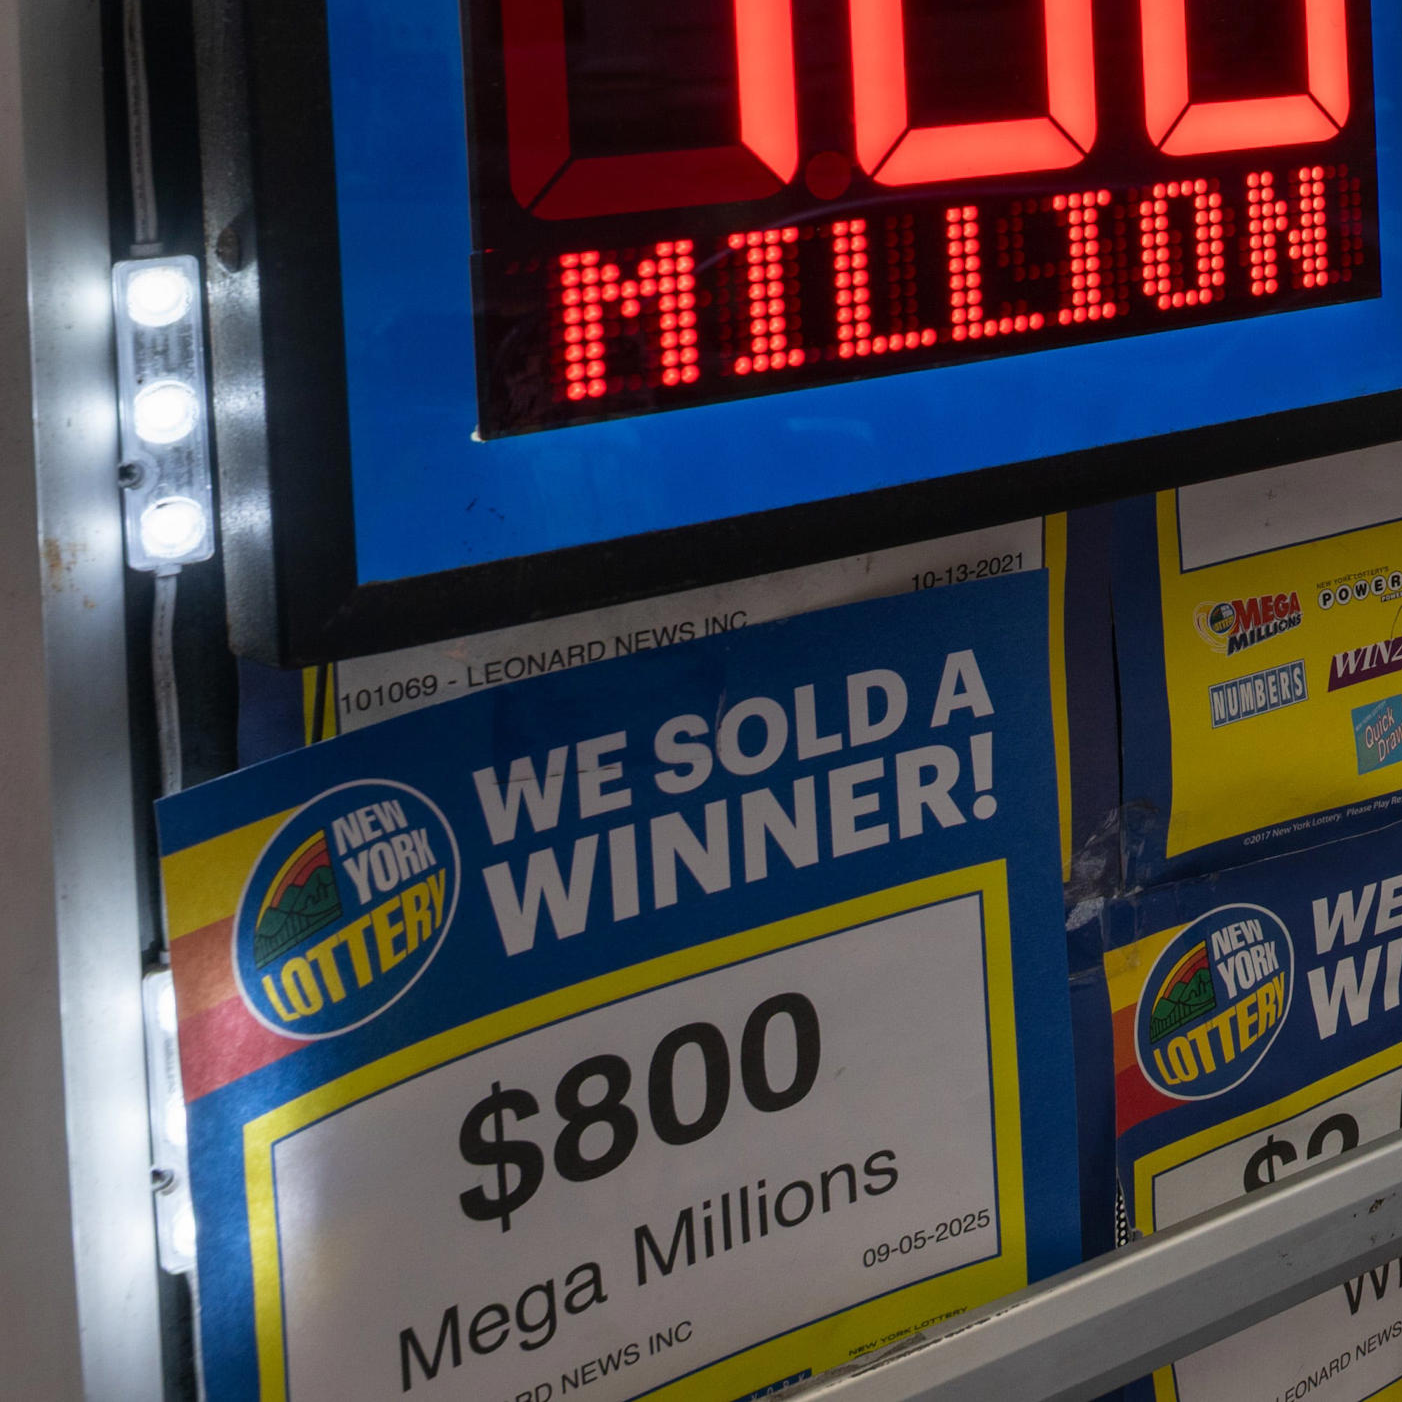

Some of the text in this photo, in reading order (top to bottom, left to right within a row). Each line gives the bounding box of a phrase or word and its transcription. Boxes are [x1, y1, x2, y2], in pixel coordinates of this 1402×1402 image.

[556, 165, 1329, 400] MILLION
[909, 551, 1026, 595] 10-13-2021
[1227, 613, 1303, 657] MILLIONS
[1230, 592, 1302, 636] MEGA
[339, 673, 440, 717] 101069
[466, 639, 607, 690] LEONARD
[612, 621, 697, 659] NEWS
[1212, 667, 1304, 722] NUMBERS
[471, 647, 996, 847] WE SOLD A
[1365, 707, 1396, 749] Quick
[332, 798, 406, 852] NEW
[482, 730, 999, 959] WINNER!
[341, 825, 437, 907] YORK
[261, 867, 449, 1026] LOTTERY
[1210, 918, 1263, 962] NEW
[1216, 940, 1280, 999] YORK
[1152, 972, 1287, 1086] LOTTERY
[457, 991, 823, 1235] $800
[397, 1146, 901, 1394] Mega Millions
[861, 1208, 993, 1271] 09-05-2025
[561, 1341, 641, 1396] NEWS
[648, 1319, 695, 1357] INC
[1355, 1319, 1402, 1361] NEWS
